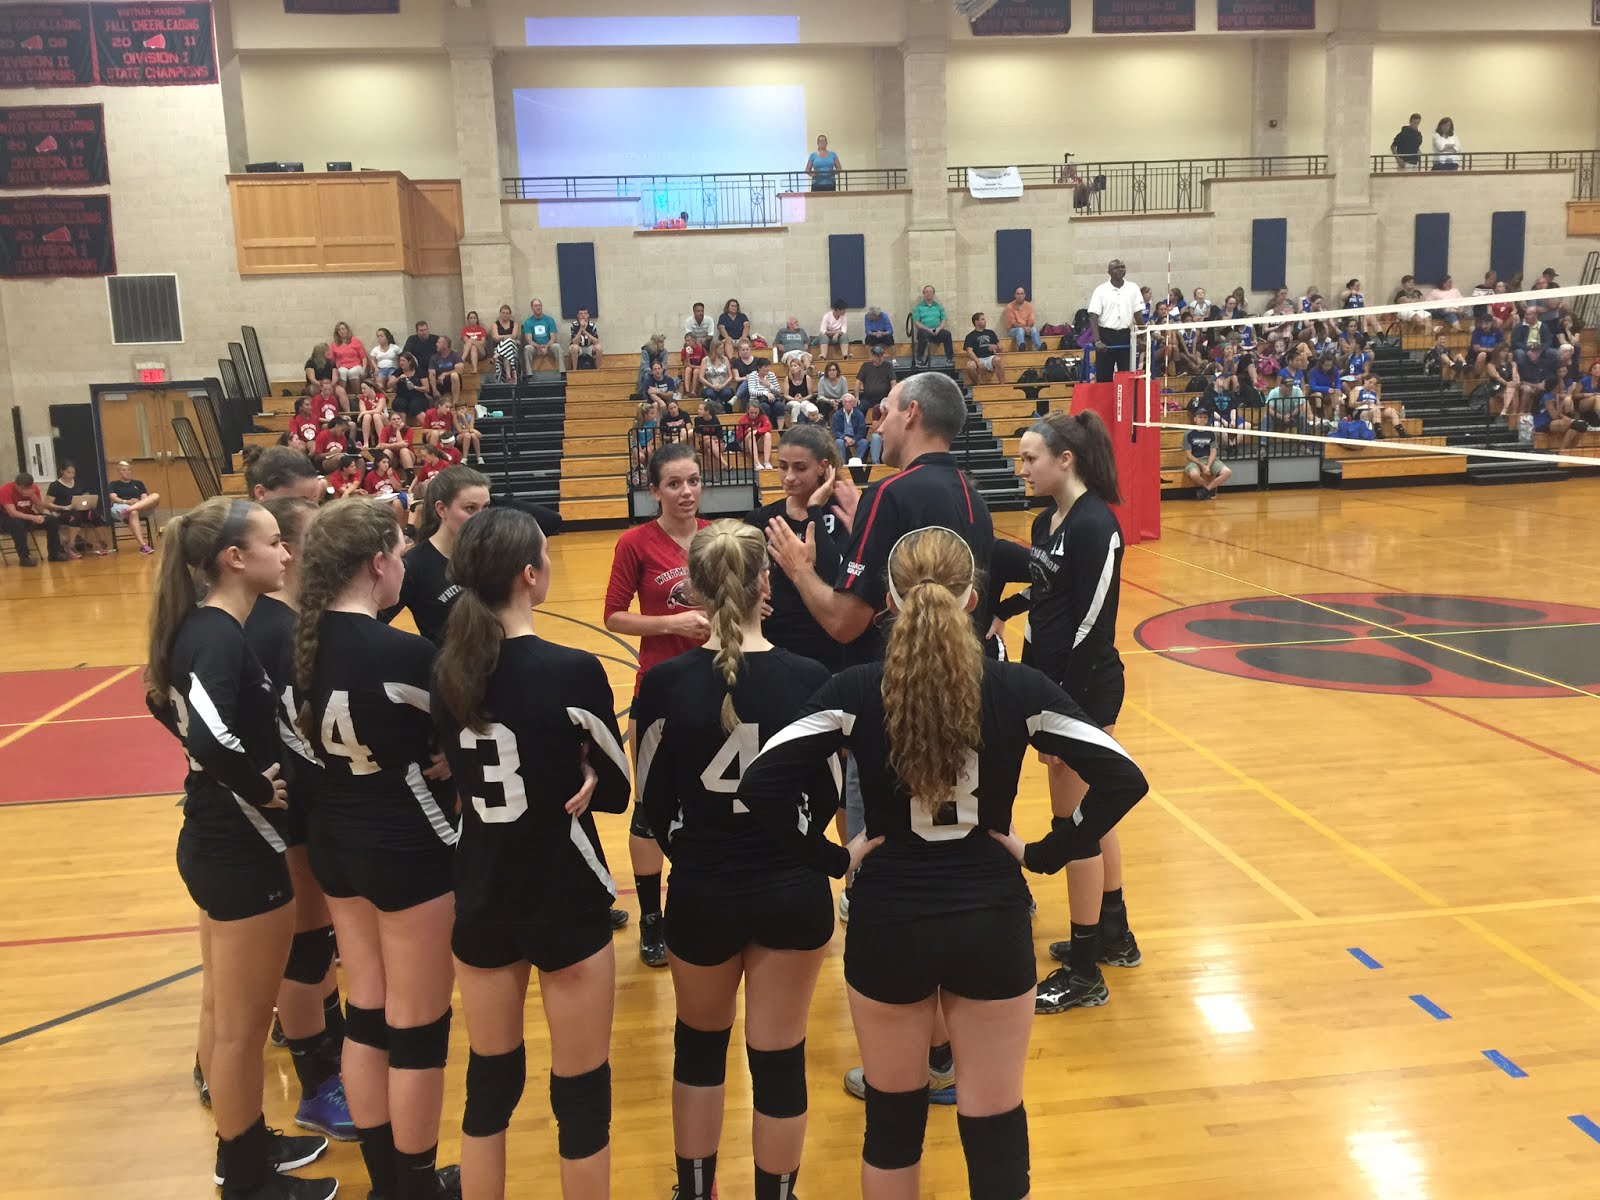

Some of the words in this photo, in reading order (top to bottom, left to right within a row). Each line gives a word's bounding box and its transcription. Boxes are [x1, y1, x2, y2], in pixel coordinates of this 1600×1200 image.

[132, 19, 199, 31] CHEERLEADING
[112, 38, 131, 47] 20
[184, 36, 196, 46] 11
[123, 52, 179, 64] DIVISION
[183, 52, 189, 64] I
[106, 67, 140, 79] STATE
[145, 66, 208, 78] CHAMPIONS
[142, 370, 163, 382] EXIT
[822, 513, 836, 534] 9
[848, 561, 866, 571] COACH
[321, 690, 382, 775] 4
[459, 722, 529, 824] 3
[700, 722, 760, 814] 4
